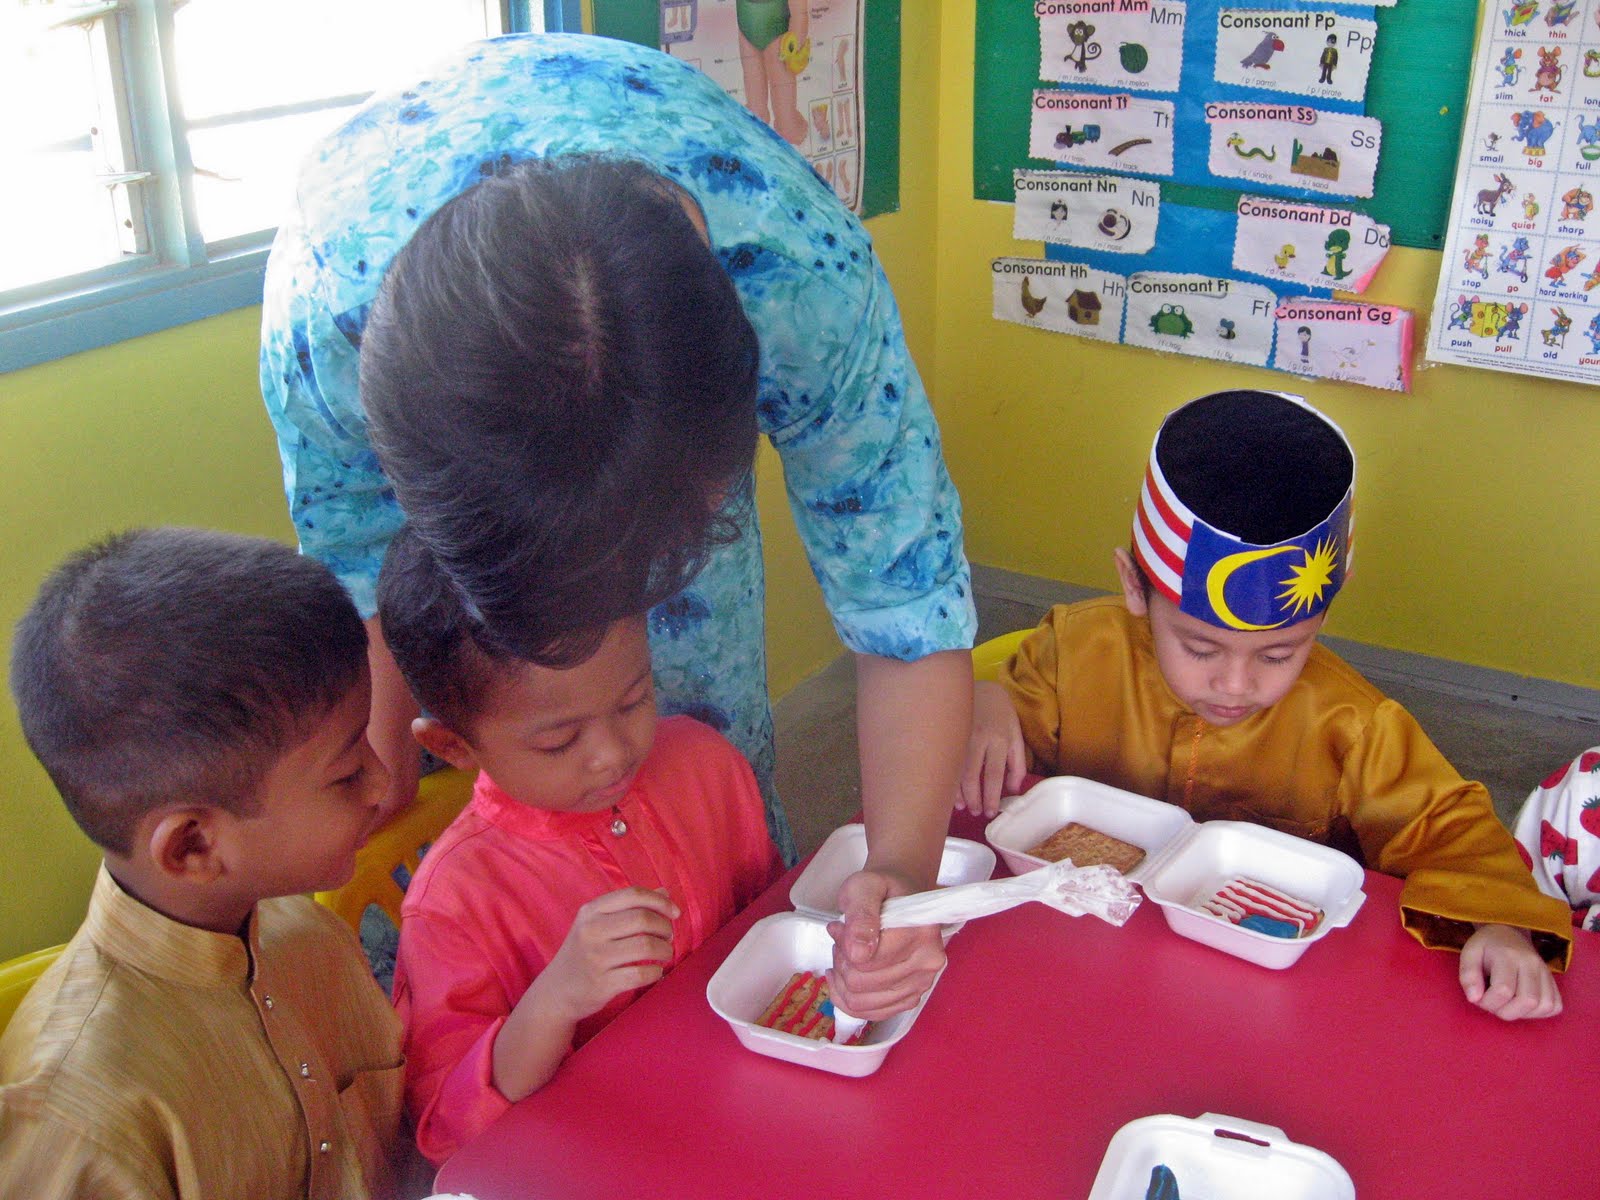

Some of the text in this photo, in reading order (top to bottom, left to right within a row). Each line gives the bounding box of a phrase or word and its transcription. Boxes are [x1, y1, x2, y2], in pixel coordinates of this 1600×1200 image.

[1036, 0, 1148, 15] Consonant Mm
[1150, 7, 1183, 25] Mm
[1220, 14, 1336, 31] Consonant Pp
[1504, 29, 1526, 37] thick
[1549, 31, 1567, 39] thin
[1347, 31, 1372, 54] Pp
[1321, 88, 1342, 97] pirate
[1495, 92, 1513, 100] slim
[1035, 96, 1128, 110] Consonant Tt
[1539, 95, 1553, 103] fat
[1206, 105, 1313, 121] Consonant Ss
[1153, 111, 1170, 128] Tt
[1351, 130, 1376, 149] Ss
[1479, 155, 1504, 163] small
[1528, 158, 1543, 167] big
[1576, 162, 1591, 170] full
[1015, 178, 1117, 193] Consonant Nn
[1132, 190, 1155, 207] Nn
[1239, 202, 1352, 226] Consonant Dd
[1470, 217, 1494, 227] noisy
[1511, 222, 1536, 231] quiet
[1558, 225, 1585, 235] sharp
[992, 261, 1088, 278] Consonant Hh
[1102, 279, 1125, 298] Hh
[1131, 281, 1212, 293] Consonant
[1462, 279, 1481, 289] stop
[1507, 285, 1519, 293] go
[1539, 288, 1589, 302] hard working
[1252, 300, 1271, 317] Ff
[1275, 307, 1392, 325] Consonant Gg
[1451, 338, 1472, 348] push
[1495, 345, 1512, 353] pull
[1543, 351, 1558, 359] old
